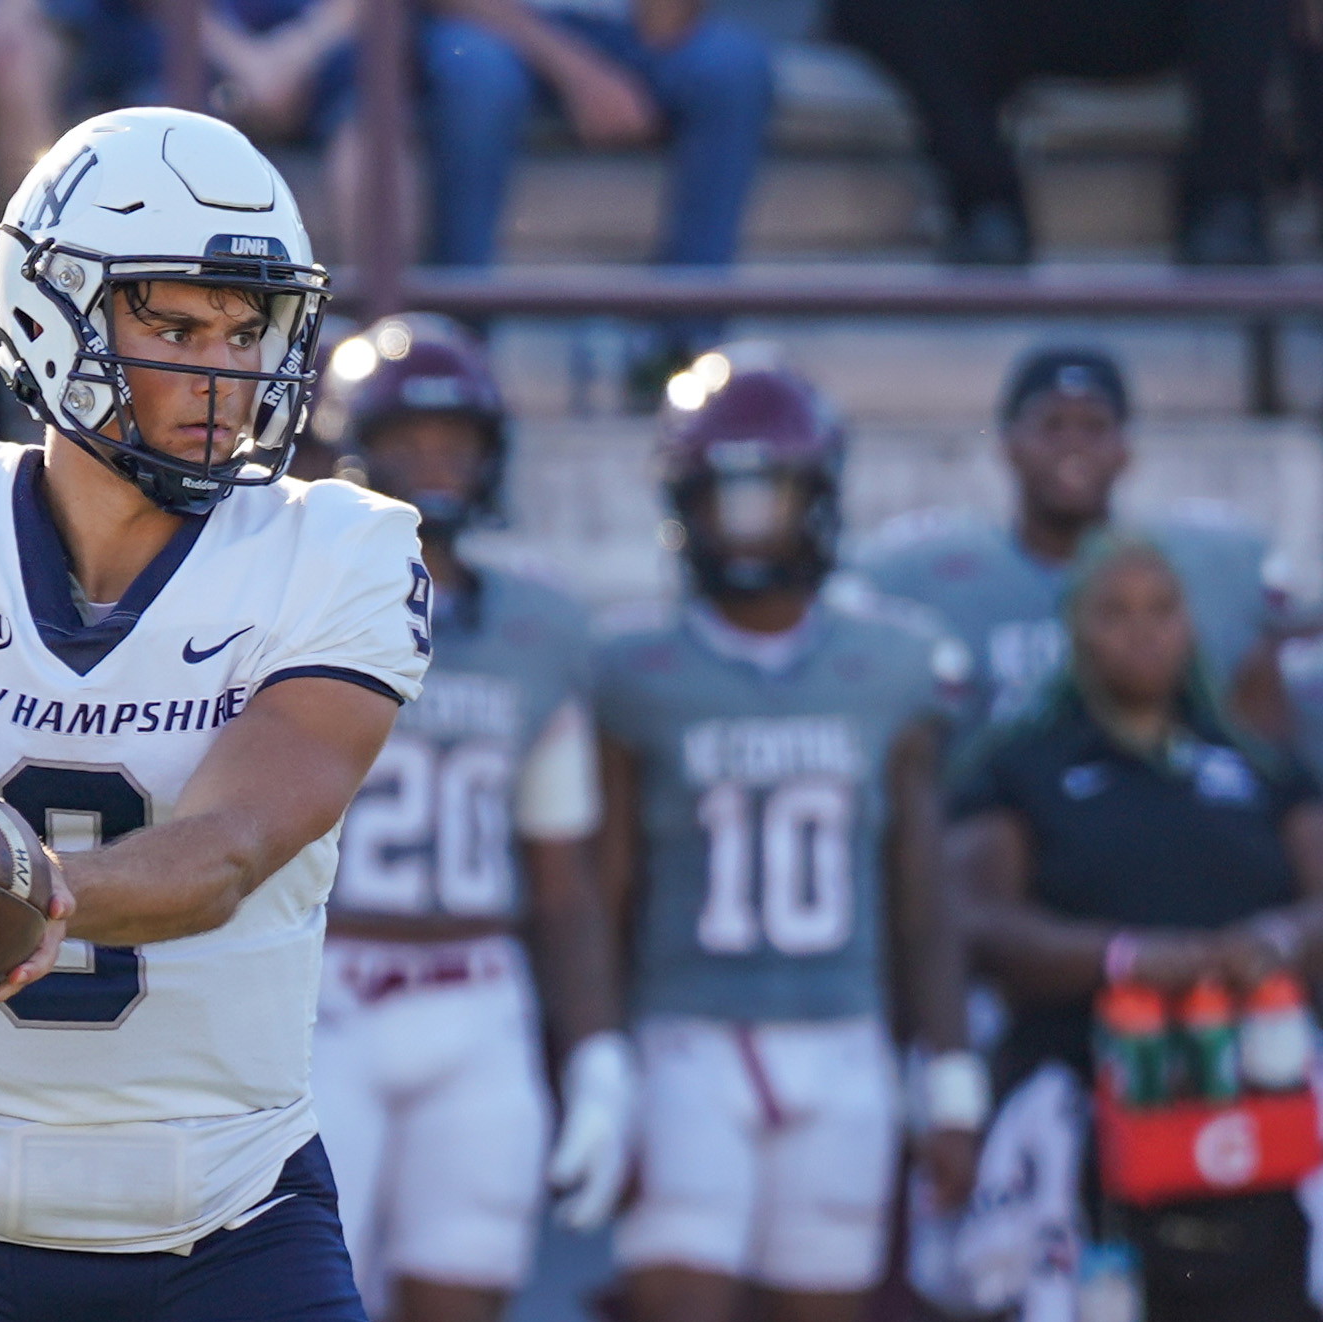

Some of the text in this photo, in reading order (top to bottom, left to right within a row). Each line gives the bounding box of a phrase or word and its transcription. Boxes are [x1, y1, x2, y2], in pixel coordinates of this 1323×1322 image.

[230, 236, 270, 257] UNH
[404, 556, 433, 663] 9
[10, 685, 247, 736] HAMPSHIRE
[697, 778, 853, 954] 10
